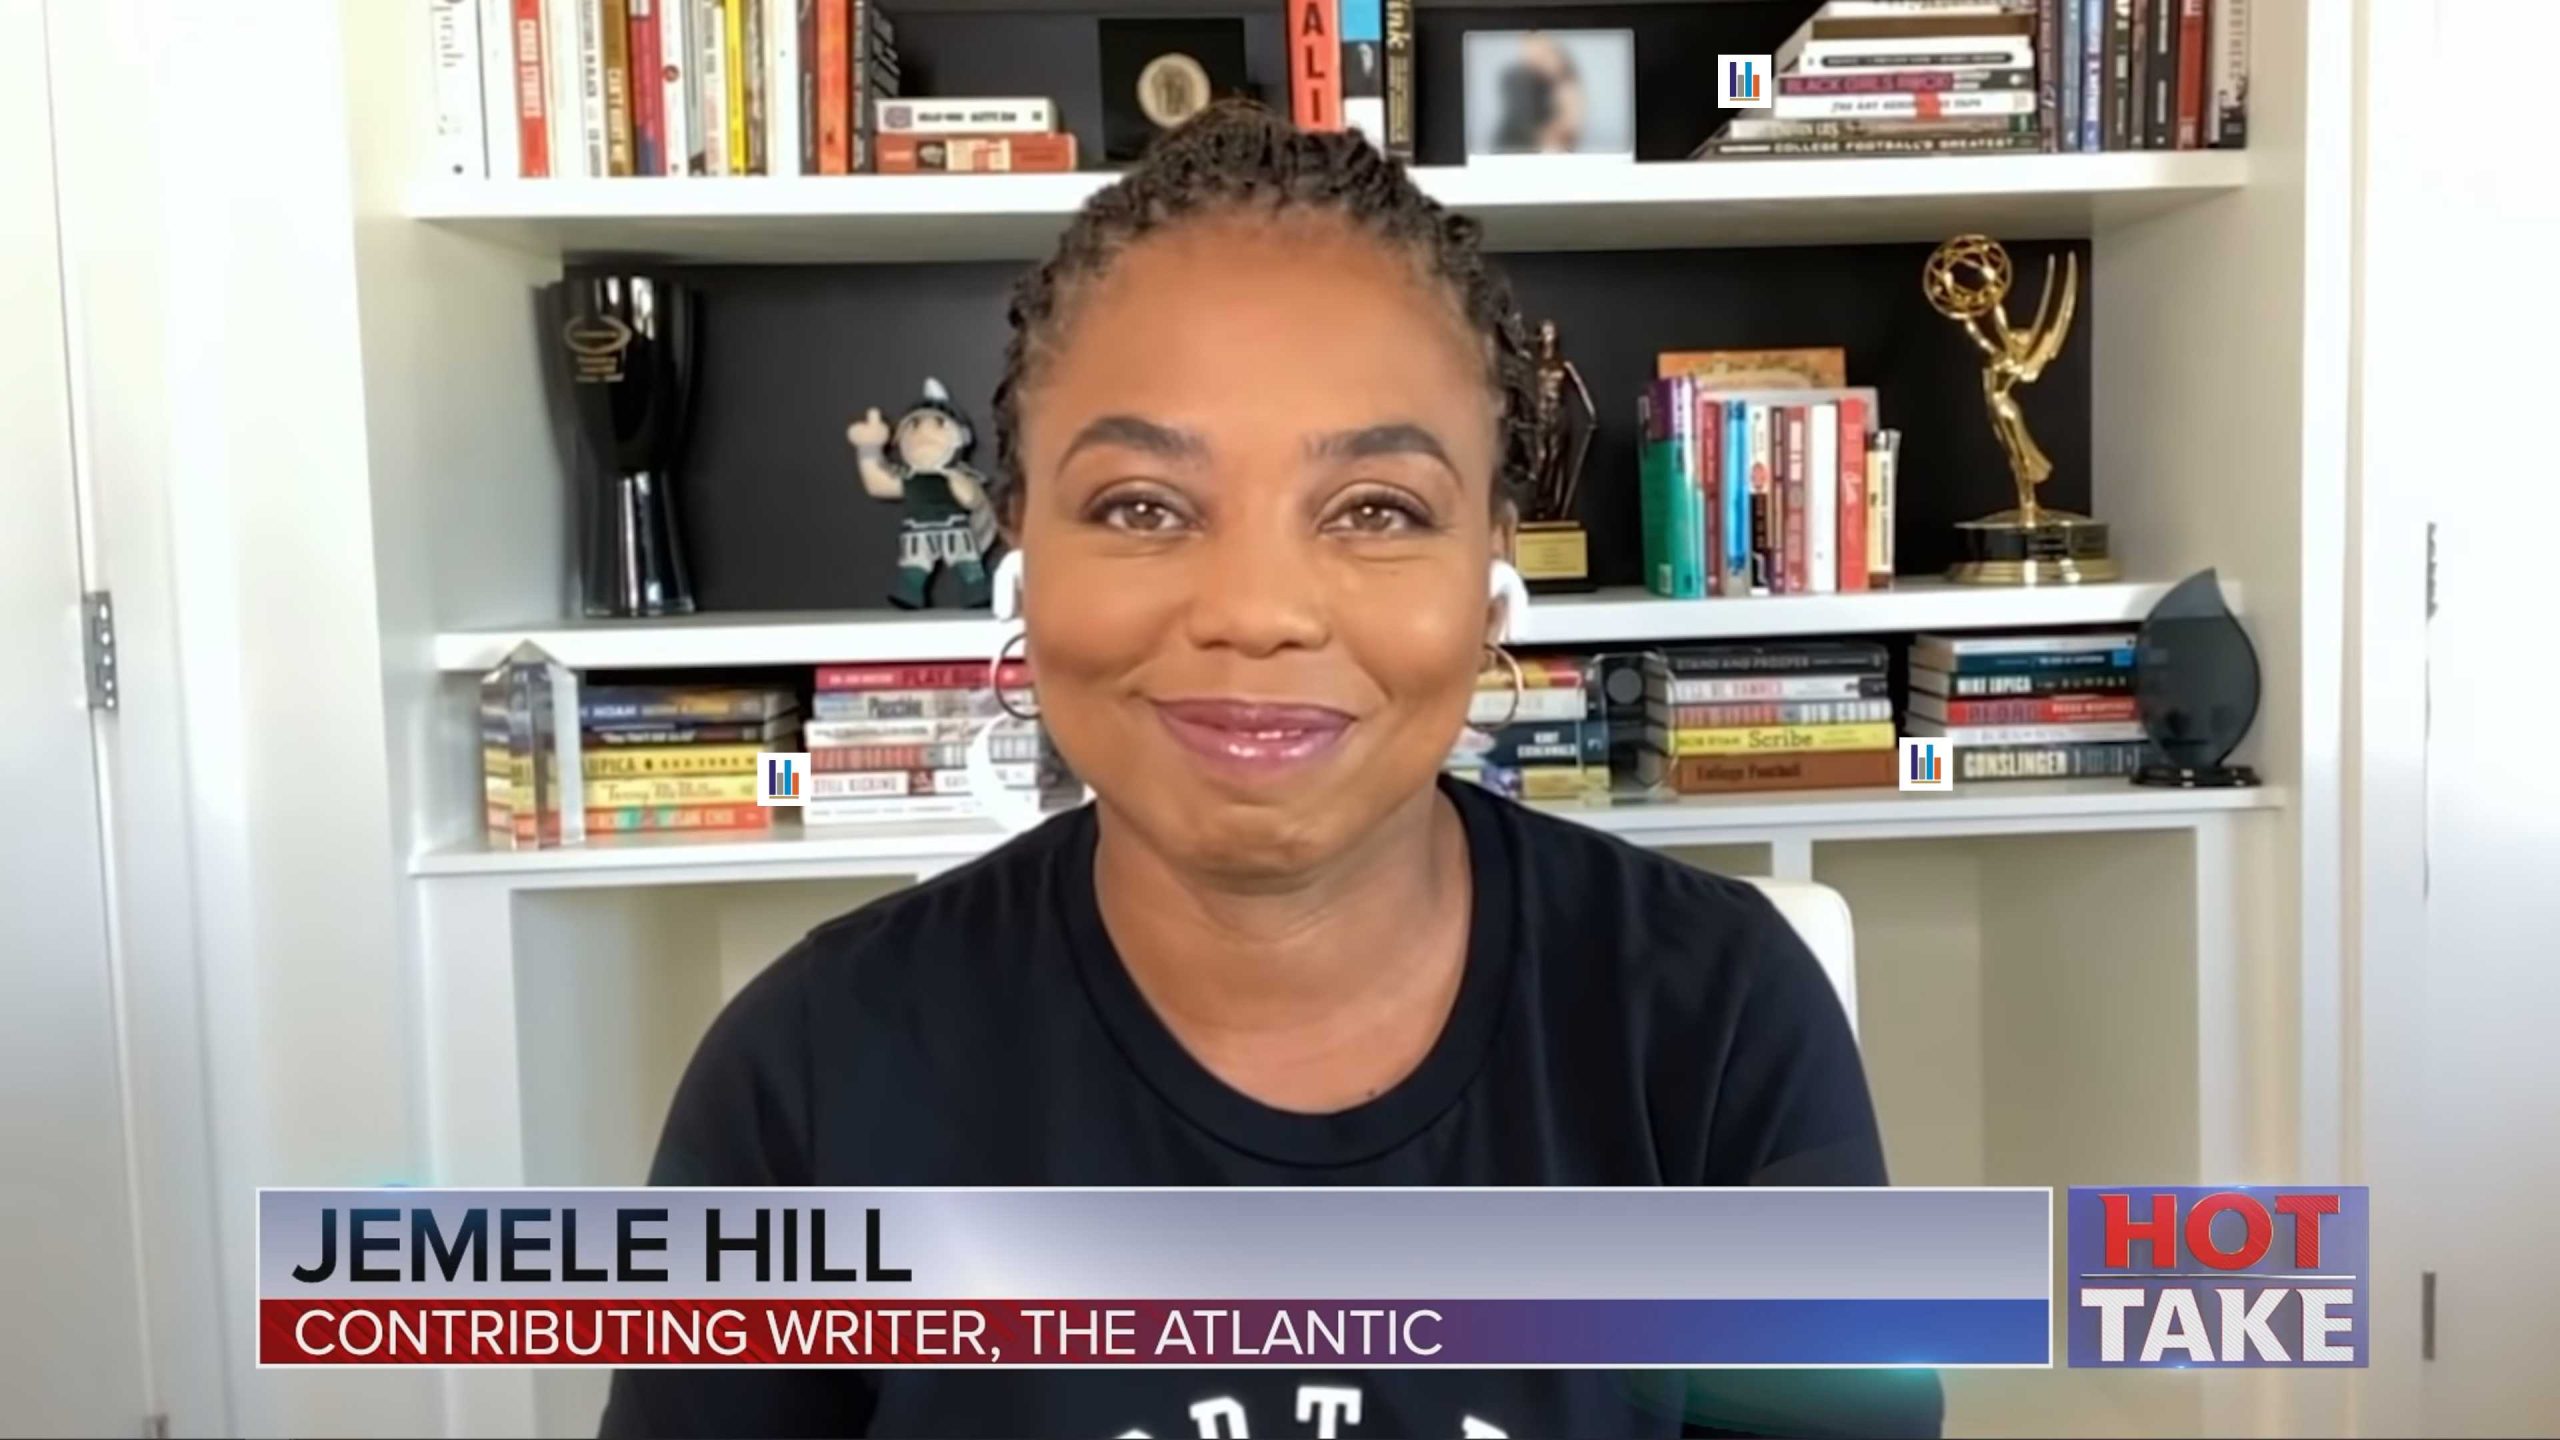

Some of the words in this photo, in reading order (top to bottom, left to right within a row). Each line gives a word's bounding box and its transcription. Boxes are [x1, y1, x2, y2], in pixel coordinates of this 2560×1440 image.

[1774, 142, 1839, 153] COLLEGE
[1845, 139, 1934, 152] FOOTBALL'S
[1938, 136, 2014, 149] GREATEST
[1989, 676, 2032, 693] LUPICA
[593, 705, 637, 718] NOAH
[1748, 729, 1813, 748] Scribe
[1697, 766, 1744, 781] College
[1747, 762, 1801, 778] Football
[1963, 751, 2067, 777] GUNSLINGER
